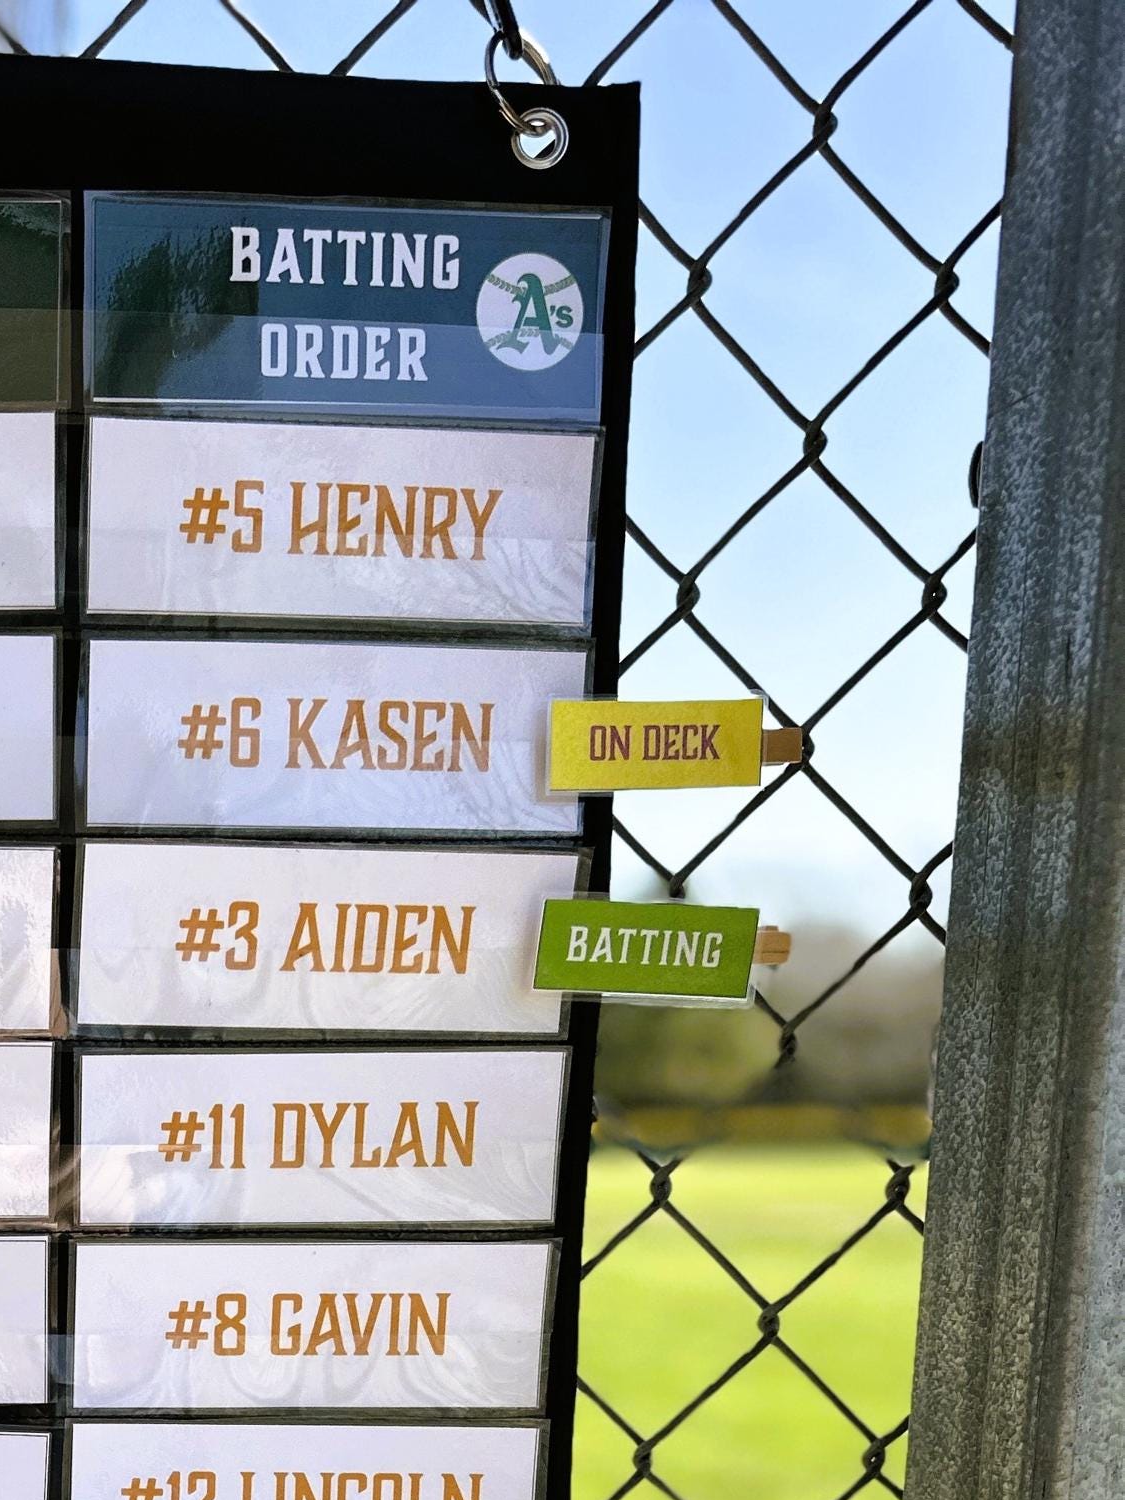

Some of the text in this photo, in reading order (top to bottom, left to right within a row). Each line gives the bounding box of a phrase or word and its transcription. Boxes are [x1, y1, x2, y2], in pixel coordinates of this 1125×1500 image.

[230, 227, 459, 289] BATTING
[261, 324, 427, 381] ORDER
[179, 480, 503, 561] #5 HENRY
[178, 697, 495, 772] #6 KASEN
[589, 724, 720, 761] ON DECK
[175, 901, 476, 974] #3 AIDEN
[566, 925, 723, 968] BATTING
[158, 1101, 479, 1170] #11 DYLAN
[165, 1293, 451, 1356] #8 GAVIN
